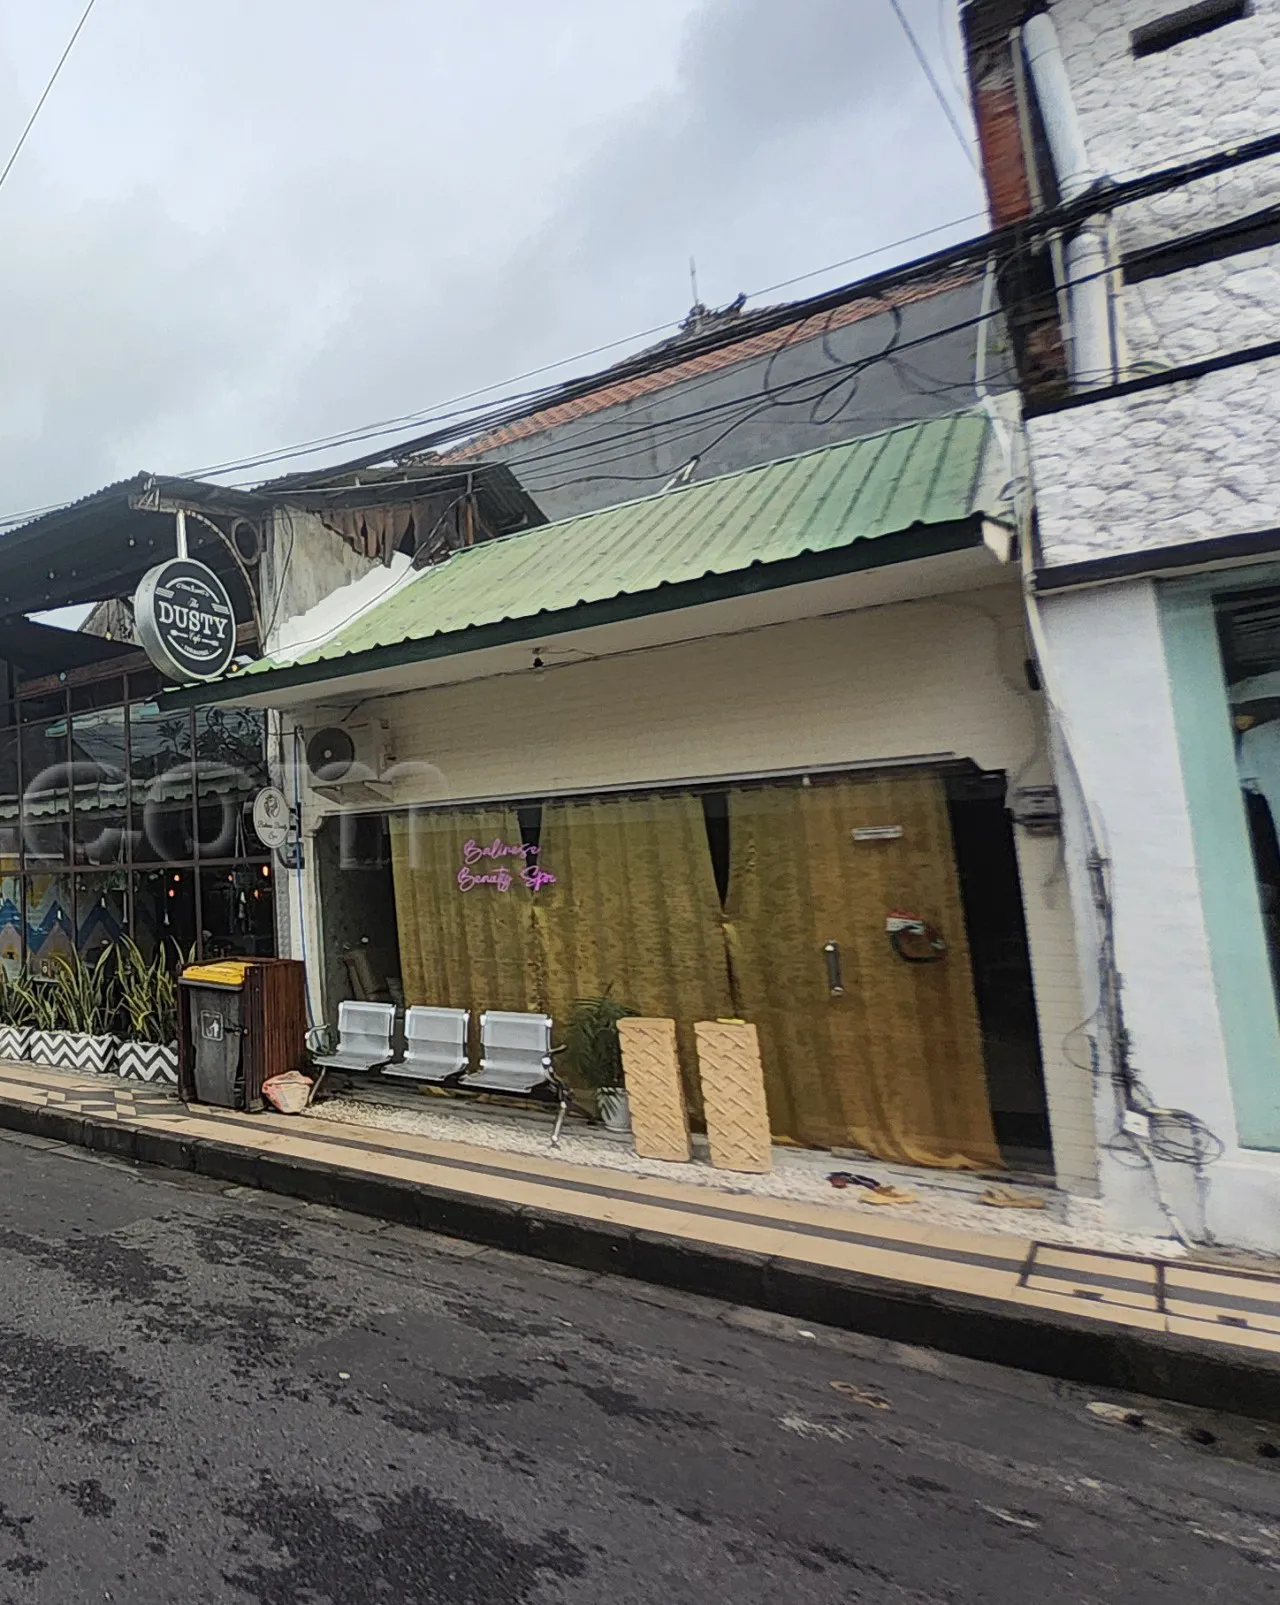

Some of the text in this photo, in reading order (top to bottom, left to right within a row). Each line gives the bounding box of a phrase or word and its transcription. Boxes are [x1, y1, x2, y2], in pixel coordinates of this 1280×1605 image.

[158, 600, 228, 639] DUSTY
[463, 838, 541, 865] Balinese
[457, 865, 557, 893] Beauty Spa
